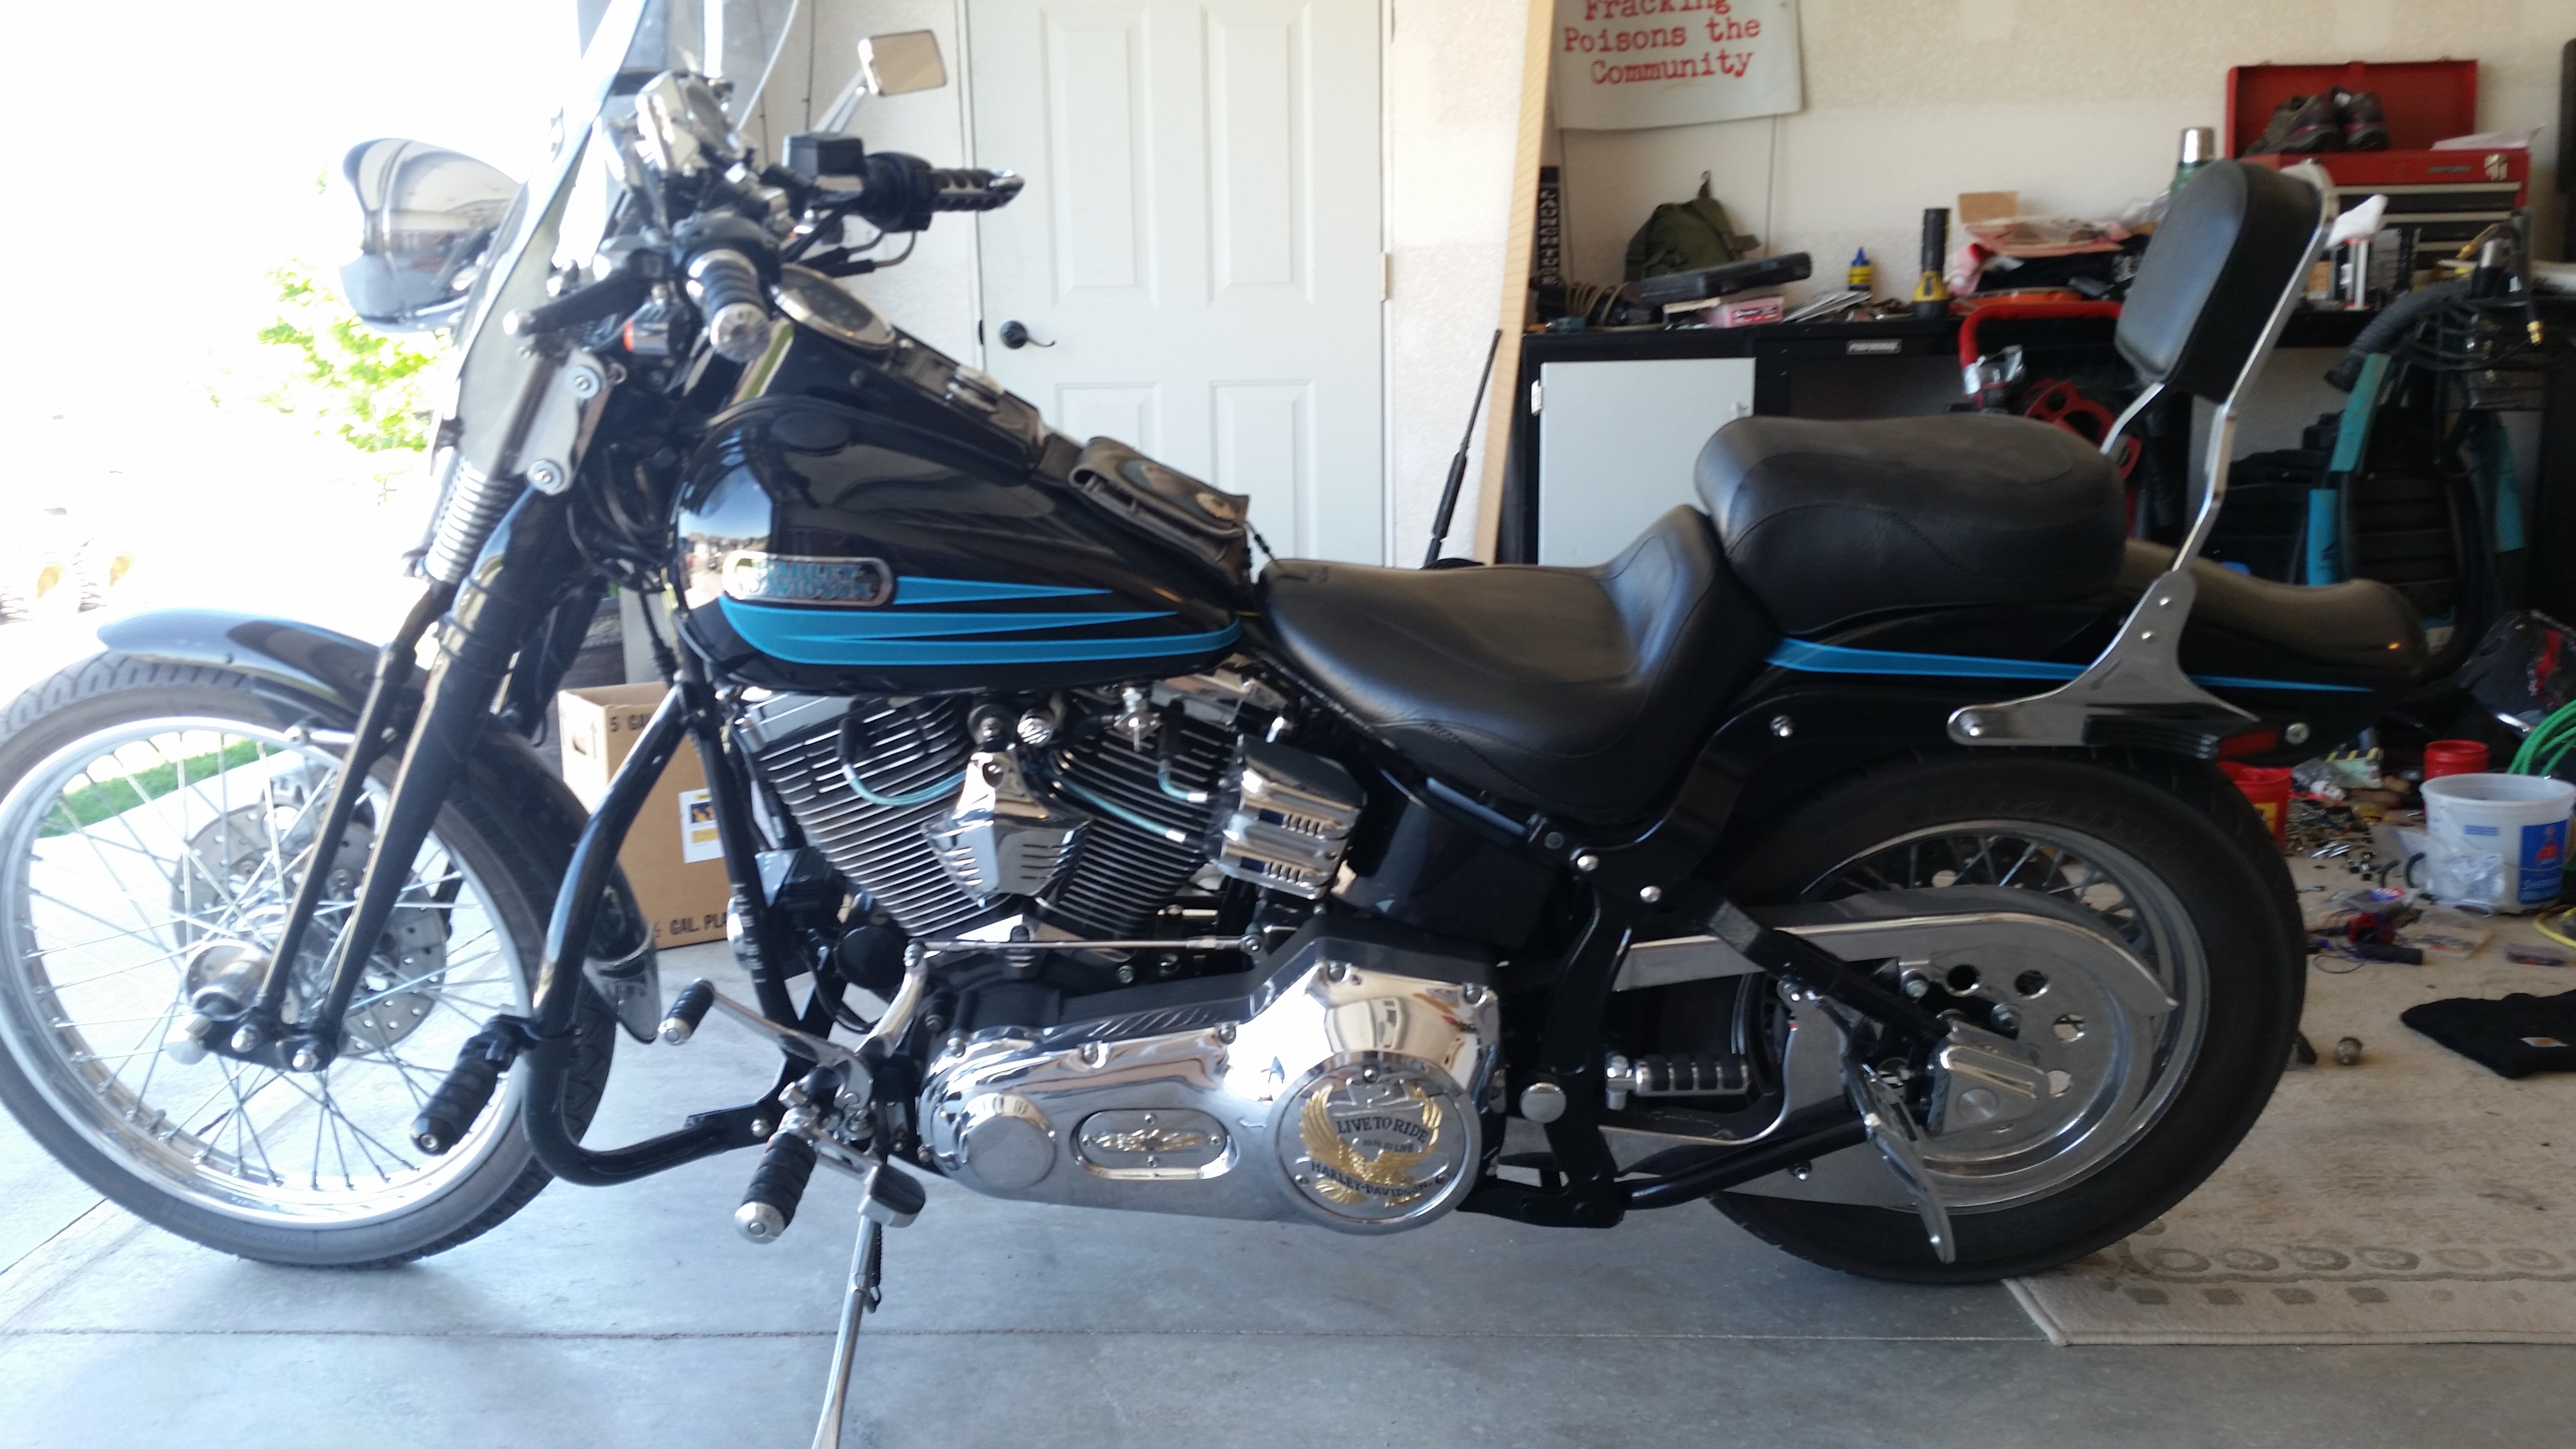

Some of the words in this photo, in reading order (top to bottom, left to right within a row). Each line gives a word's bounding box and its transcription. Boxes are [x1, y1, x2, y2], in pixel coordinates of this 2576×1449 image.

[1563, 26, 1687, 53] Poisons
[1705, 16, 1761, 43] the
[1591, 48, 1755, 84] Community
[610, 716, 620, 732] 5
[1336, 1117, 1372, 1134] LIVE
[1372, 1116, 1392, 1129] TO
[1393, 1118, 1430, 1143] RIDE
